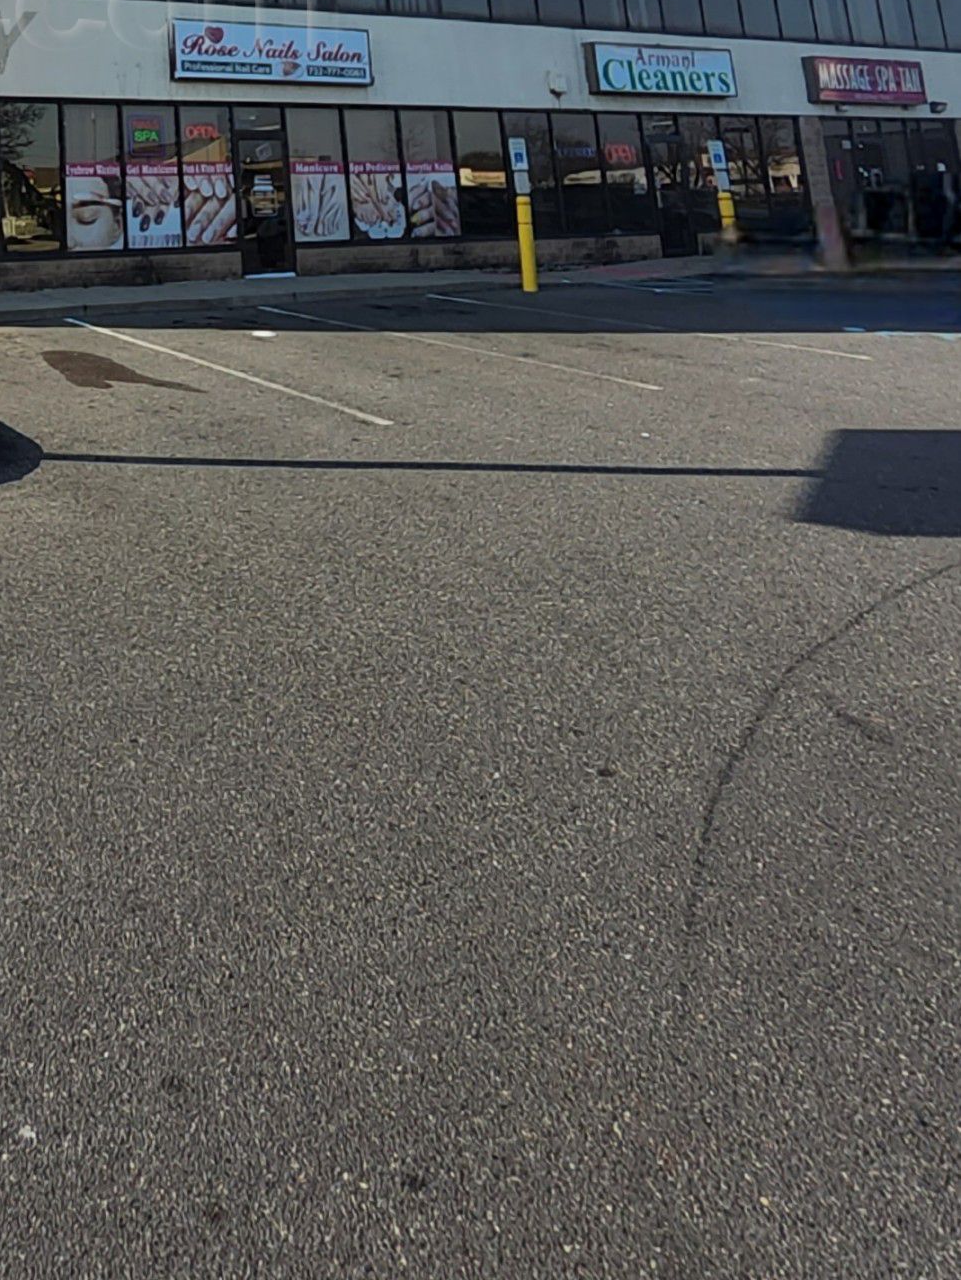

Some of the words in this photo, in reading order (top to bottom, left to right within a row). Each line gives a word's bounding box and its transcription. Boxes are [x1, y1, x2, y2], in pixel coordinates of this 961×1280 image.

[181, 34, 239, 57] Rose
[243, 38, 303, 61] Nails
[307, 40, 365, 63] Salon
[603, 58, 731, 93] Cleaners
[818, 62, 872, 90] MASSAGE
[133, 130, 159, 142] SPA
